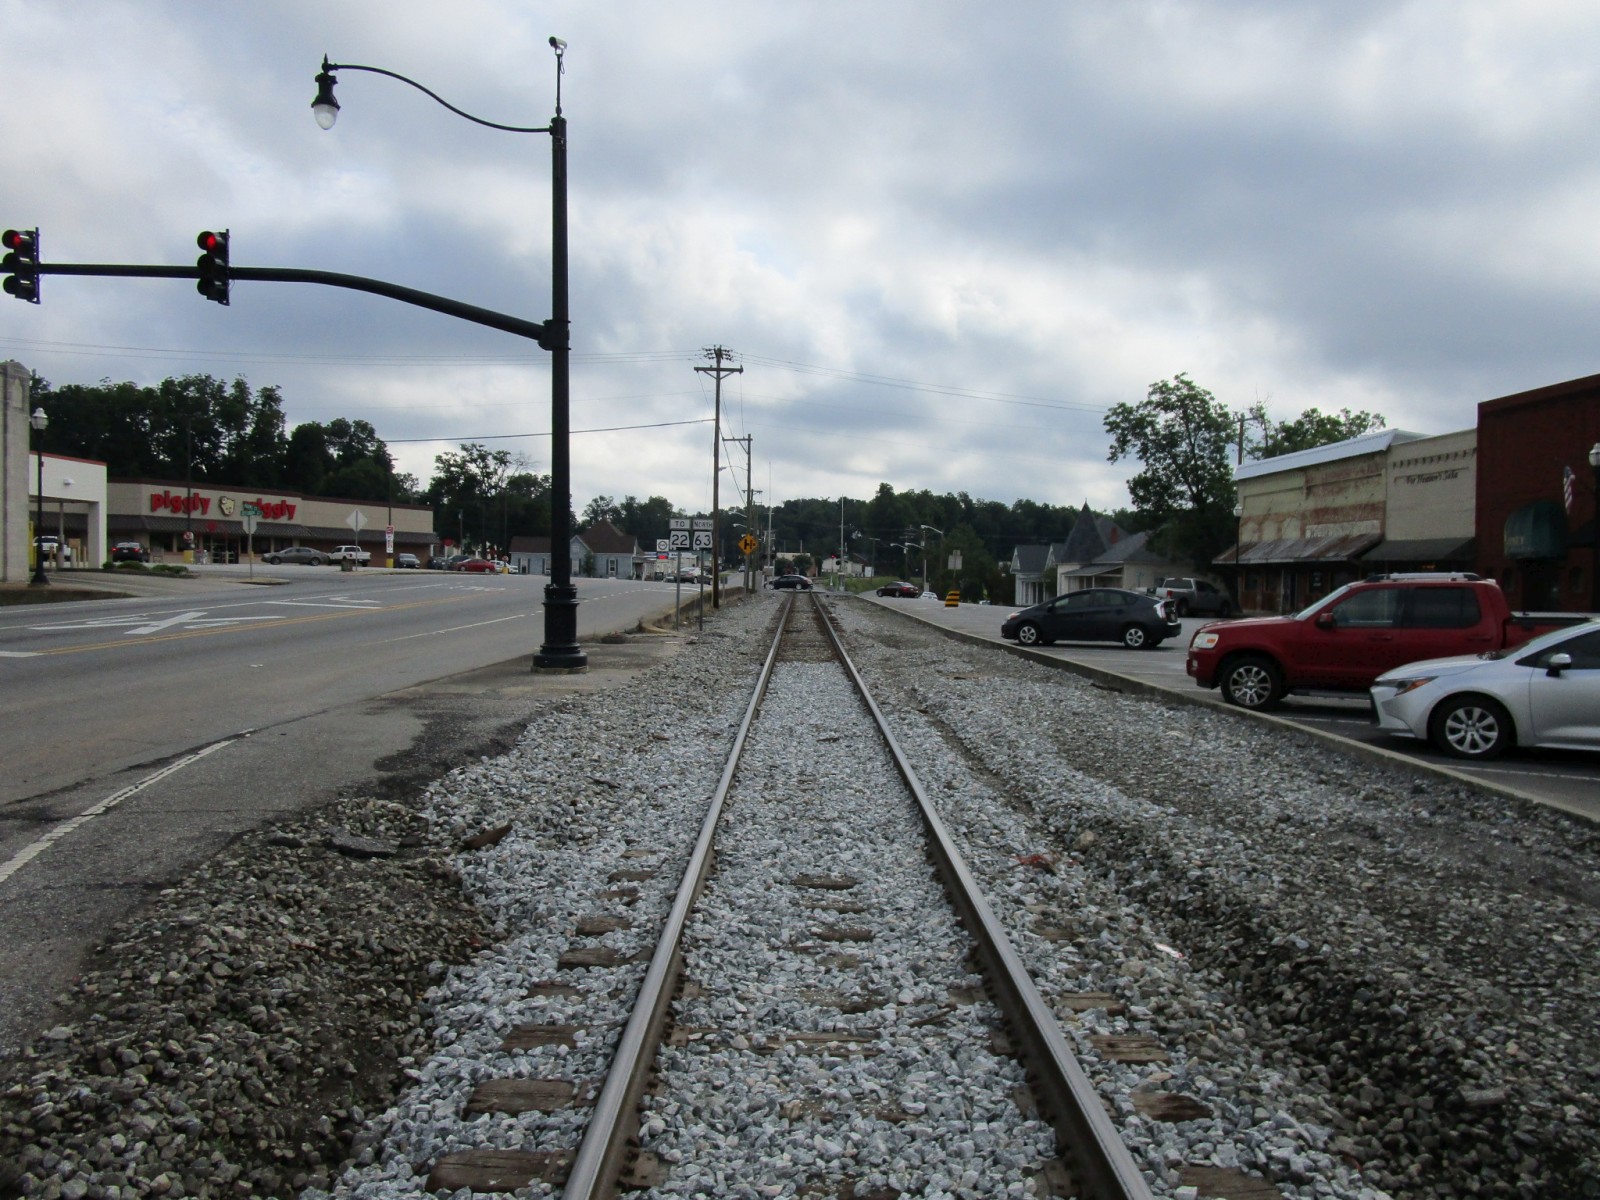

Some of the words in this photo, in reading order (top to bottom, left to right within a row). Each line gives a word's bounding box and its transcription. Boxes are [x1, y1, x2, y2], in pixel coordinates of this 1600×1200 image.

[151, 490, 211, 515] piggly
[672, 534, 688, 546] 22
[695, 534, 711, 546] 63
